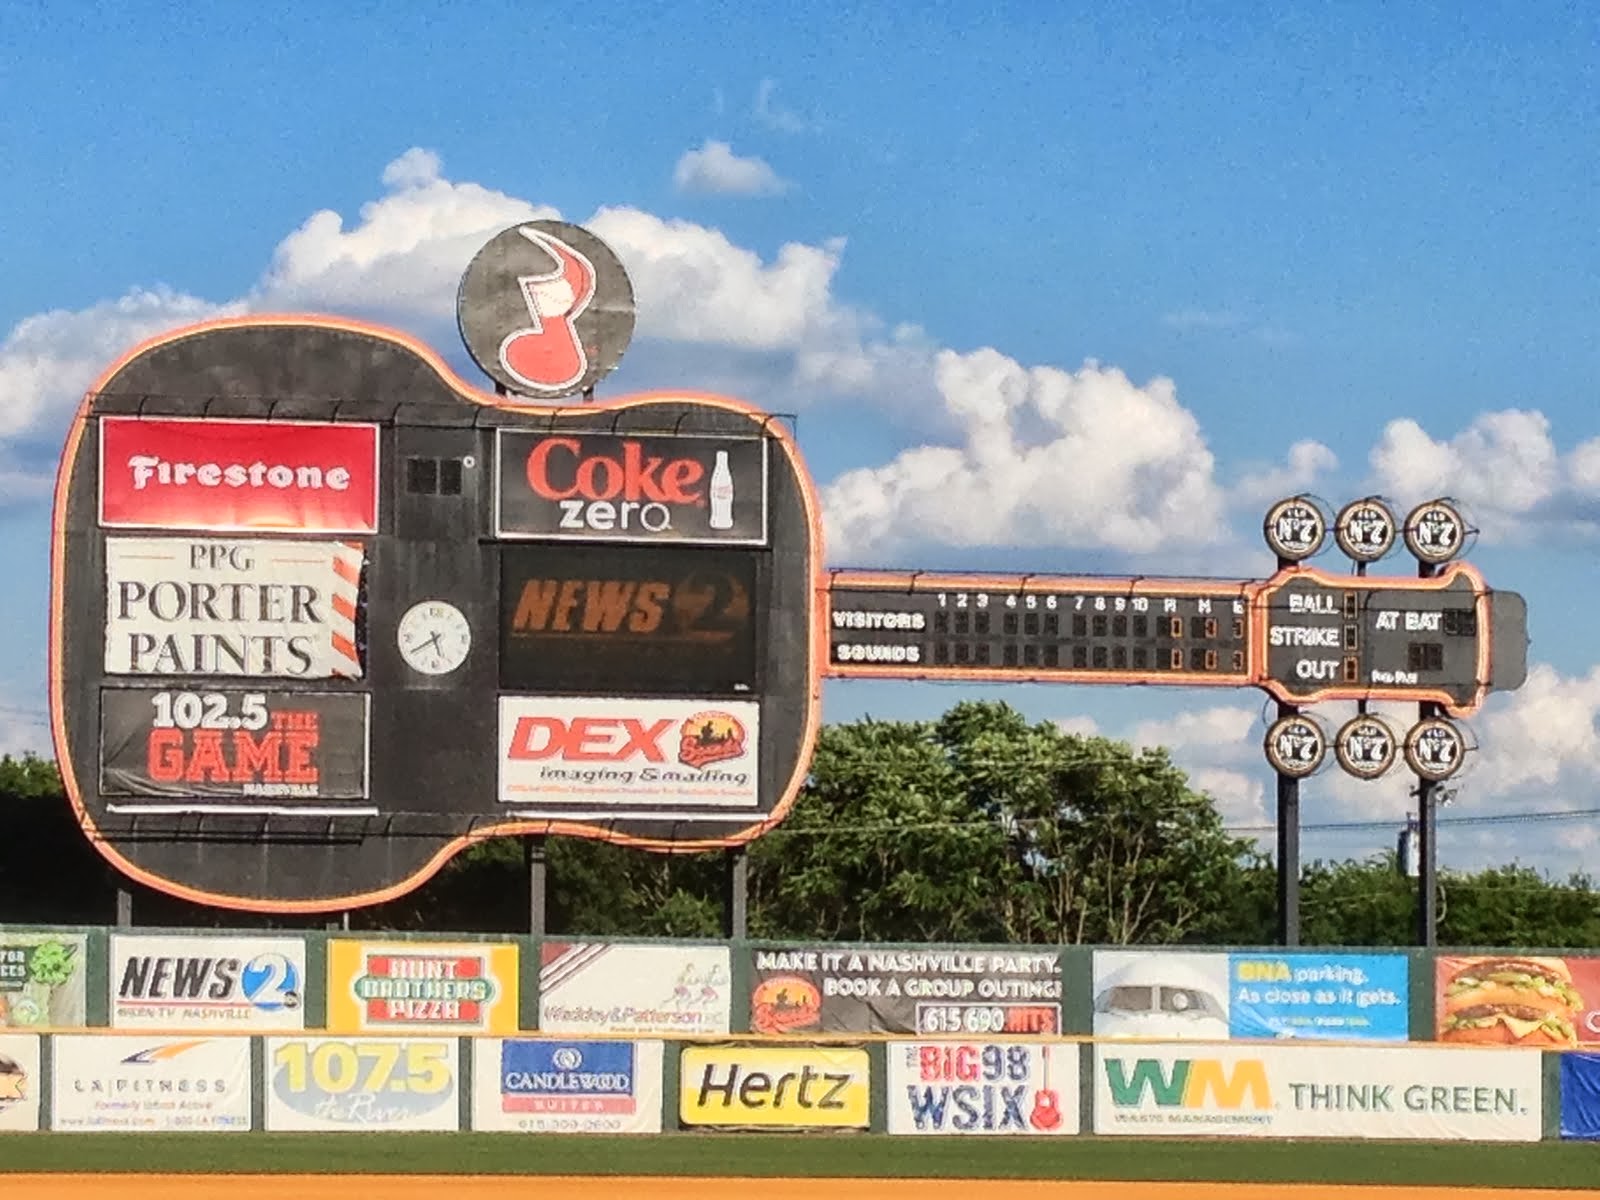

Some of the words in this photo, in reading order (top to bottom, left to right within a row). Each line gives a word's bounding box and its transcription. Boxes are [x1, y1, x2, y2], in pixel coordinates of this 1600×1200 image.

[128, 455, 350, 490] Firestone
[527, 438, 705, 504] Coke
[559, 500, 672, 531] zero
[190, 544, 254, 571] PPG
[117, 581, 322, 623] PORTER
[513, 579, 670, 633] NEWS
[938, 594, 946, 607] 1
[957, 594, 968, 608] 2
[977, 594, 989, 608] 3
[1006, 595, 1016, 609] 4
[1026, 596, 1037, 609] 5
[1047, 596, 1057, 609] 6
[1074, 597, 1085, 610] 7
[1095, 597, 1106, 610] 8
[1132, 598, 1148, 612] 10
[1289, 594, 1339, 614] BALL
[832, 611, 925, 629] VISITORS
[1375, 611, 1400, 630] AT
[1405, 612, 1442, 630] BAT
[1270, 625, 1340, 646] STRIKE
[127, 633, 314, 675] PAINTS
[837, 645, 920, 662] SOUNDS
[1296, 659, 1340, 679] OUT
[151, 692, 268, 730] 102.5
[270, 711, 318, 729] THE
[508, 717, 678, 762] DEX
[148, 728, 319, 783] GAME
[540, 767, 633, 783] imaging
[390, 959, 460, 979] HUNT
[757, 951, 817, 970] MAKE
[822, 952, 841, 971] IT
[847, 953, 864, 971] A
[868, 952, 985, 973] NASHVILLE
[989, 954, 1062, 974] PARTY.
[1294, 965, 1368, 985] parking.
[119, 957, 243, 999] NEWS
[823, 978, 881, 996] BOOK
[885, 978, 901, 996] A
[904, 978, 974, 997] GROUP
[978, 979, 1063, 998] OUTING!
[390, 1001, 460, 1020] PIZZA
[1265, 987, 1310, 1004] close
[1357, 989, 1401, 1008] gets.
[924, 1006, 961, 1032] 615
[963, 1007, 1004, 1032] 690
[274, 1041, 453, 1095] 107.5
[920, 1046, 978, 1081] BIG
[982, 1045, 1030, 1080] 98
[506, 1072, 630, 1090] CANDLEWOOD
[698, 1063, 852, 1108] Hertz
[1103, 1058, 1273, 1110] WM
[907, 1084, 1028, 1130] WSIX
[1289, 1083, 1394, 1112] THINK
[1403, 1085, 1528, 1115] GREEN.
